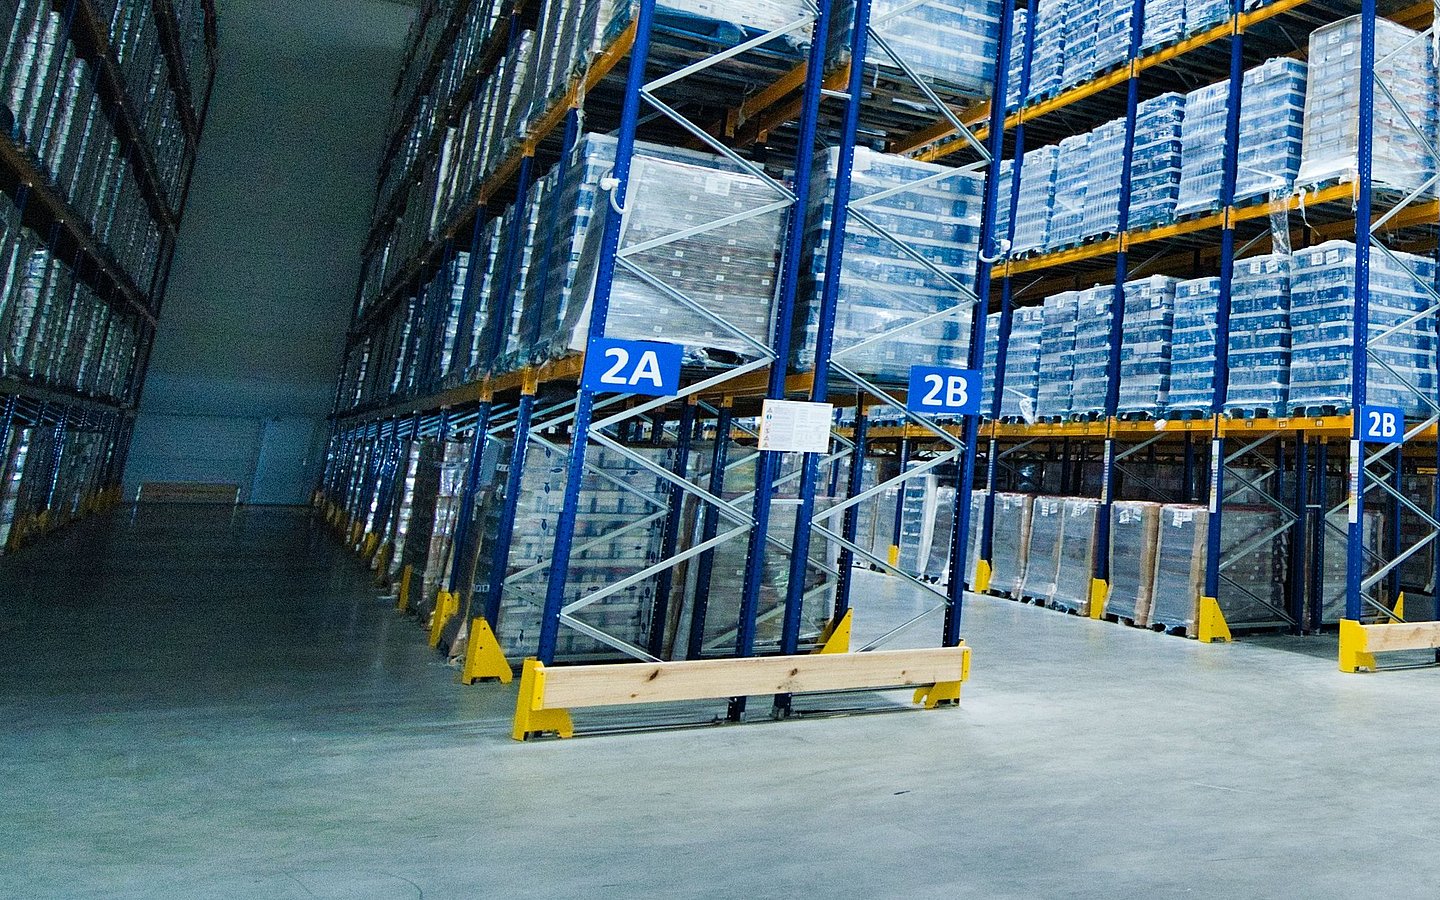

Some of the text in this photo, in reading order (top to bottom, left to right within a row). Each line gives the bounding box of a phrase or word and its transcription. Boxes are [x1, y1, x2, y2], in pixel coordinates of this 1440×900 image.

[600, 347, 663, 387] 2A
[921, 374, 968, 407] 2B
[1368, 411, 1397, 438] 2B
